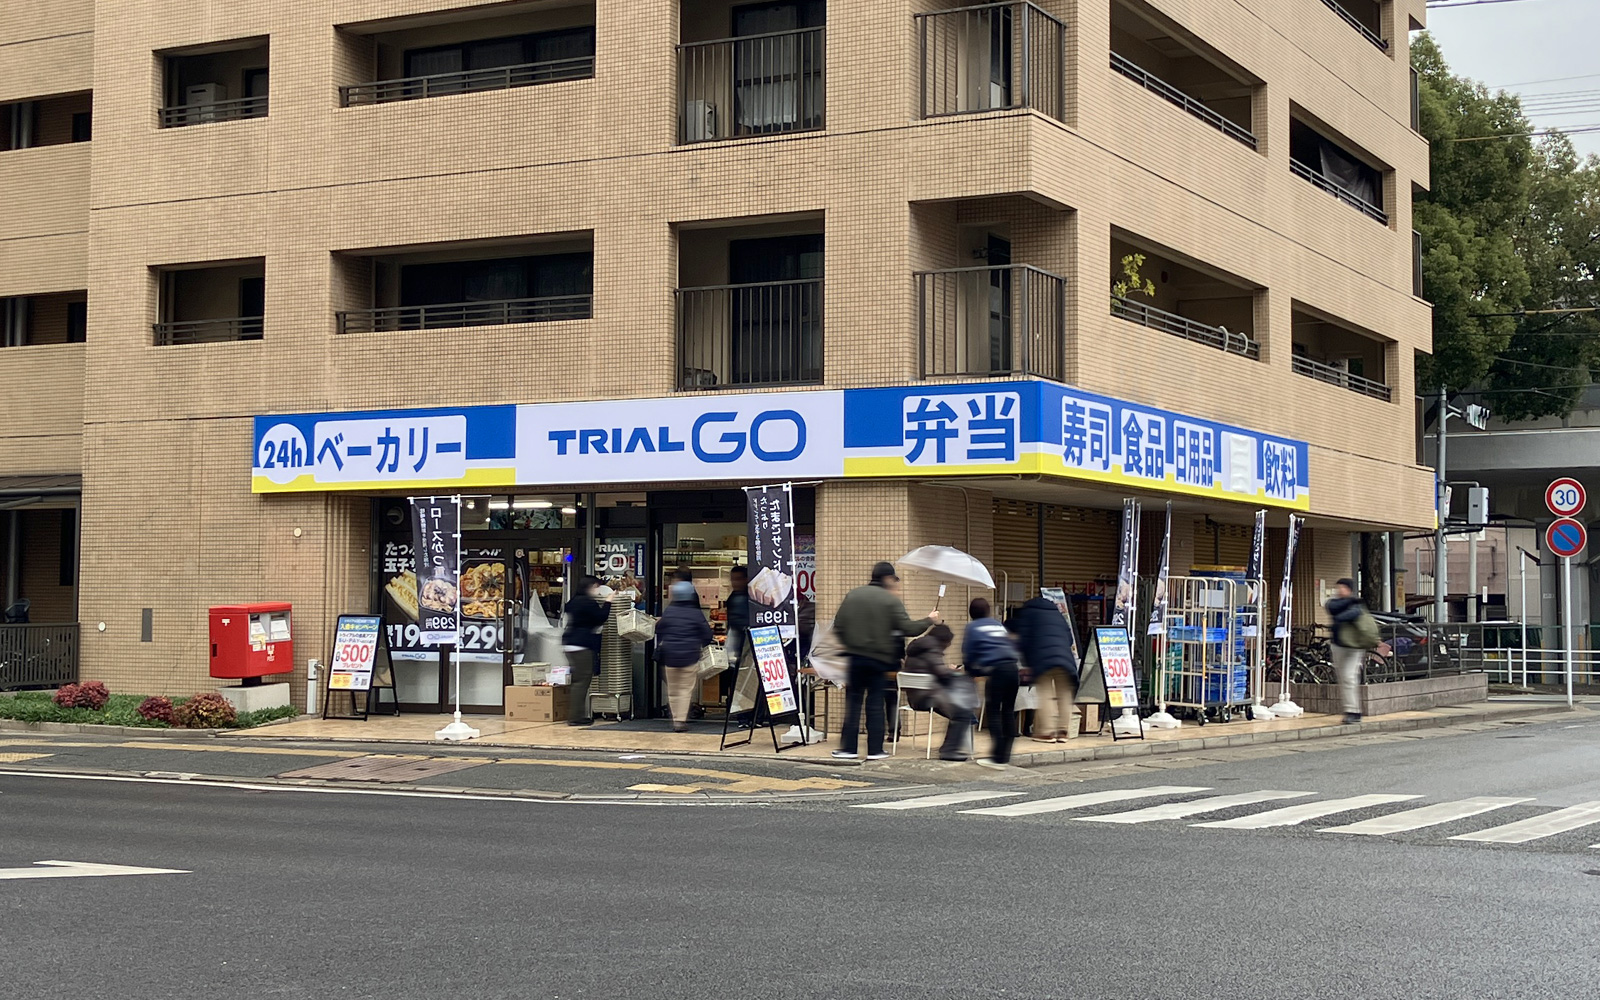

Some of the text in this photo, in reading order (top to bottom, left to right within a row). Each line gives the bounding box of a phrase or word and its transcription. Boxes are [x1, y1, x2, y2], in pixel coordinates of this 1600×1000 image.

[548, 409, 807, 463] TRIAL GO
[904, 395, 1016, 464] 弁当
[1062, 400, 1110, 467] 寿司
[263, 440, 303, 469] 24h
[317, 426, 463, 474] ベーカリー
[1122, 413, 1165, 476] 食品
[1174, 424, 1214, 487] 日用品
[1263, 438, 1296, 500] 飲料
[1555, 489, 1577, 506] 30
[385, 541, 415, 556] たっ
[595, 544, 628, 553] RIAL
[395, 624, 432, 648] 19
[340, 644, 370, 663] 500
[1108, 658, 1129, 678] 500
[763, 658, 785, 682] 500
